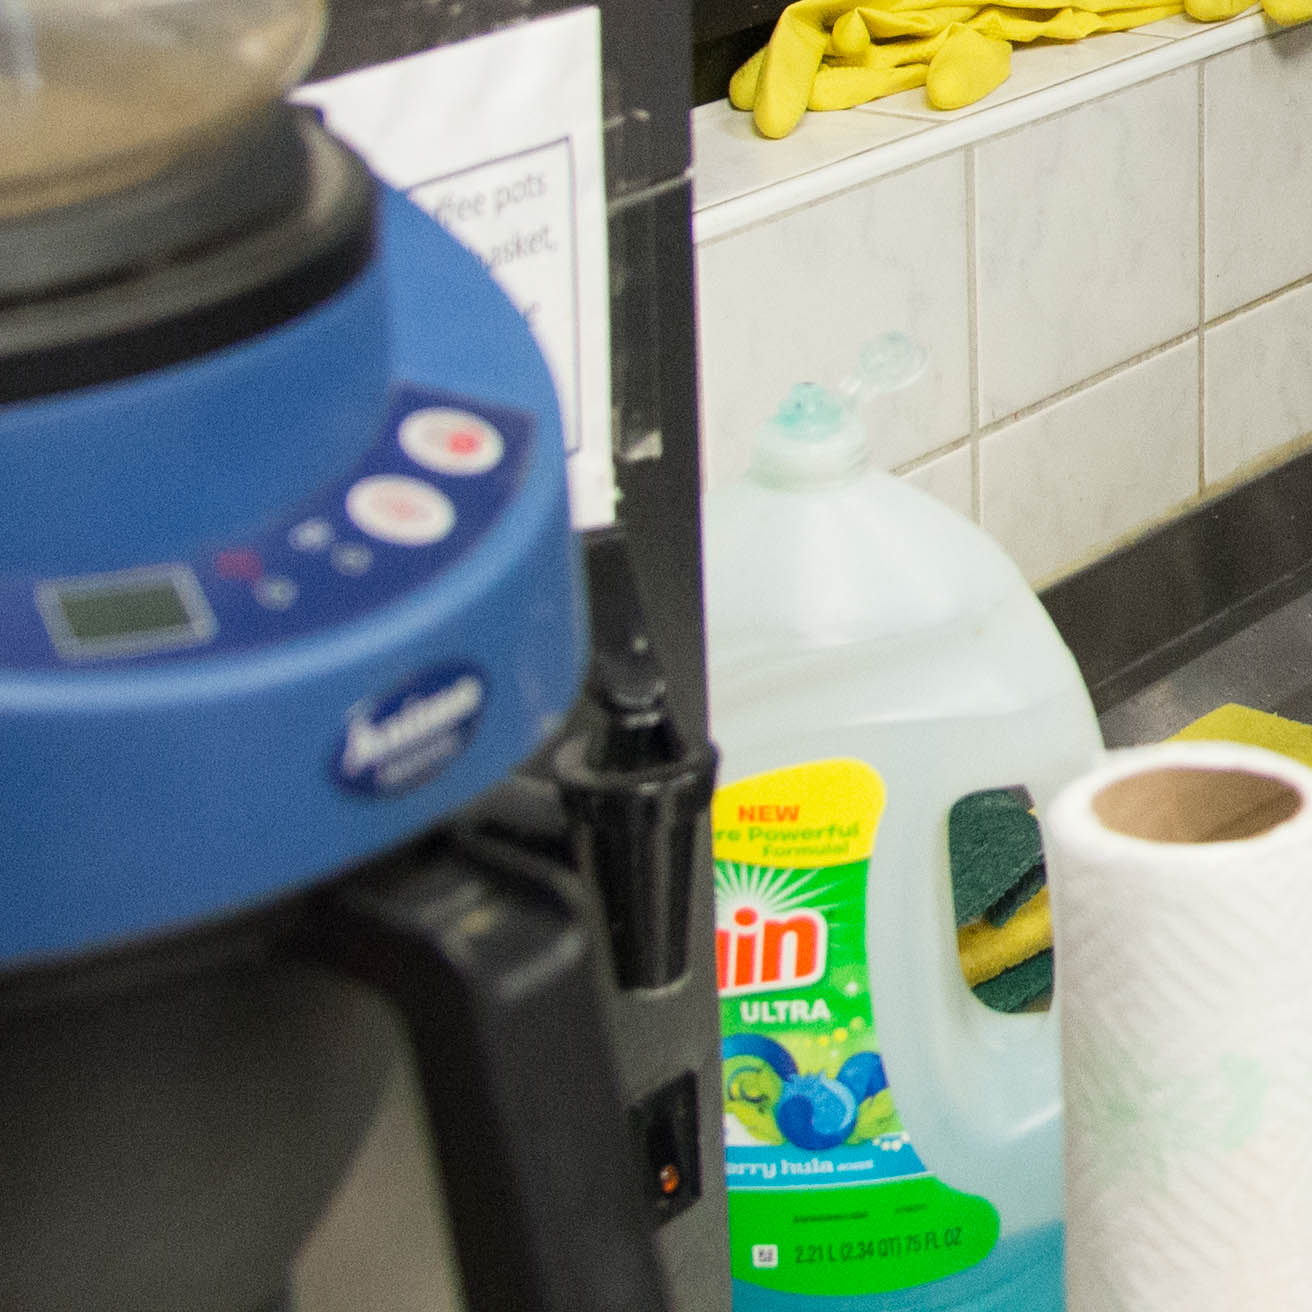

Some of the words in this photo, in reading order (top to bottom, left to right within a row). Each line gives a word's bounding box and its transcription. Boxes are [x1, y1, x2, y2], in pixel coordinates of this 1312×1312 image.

[494, 172, 547, 216] pots
[738, 804, 800, 822] NEW
[715, 828, 741, 841] re
[748, 822, 860, 841] Powerful
[740, 999, 831, 1023] ULTRA
[780, 1158, 834, 1175] hula
[794, 1244, 824, 1264] 2.21
[828, 1245, 836, 1262] L
[904, 1233, 921, 1253] 75
[944, 1227, 962, 1247] OZ
